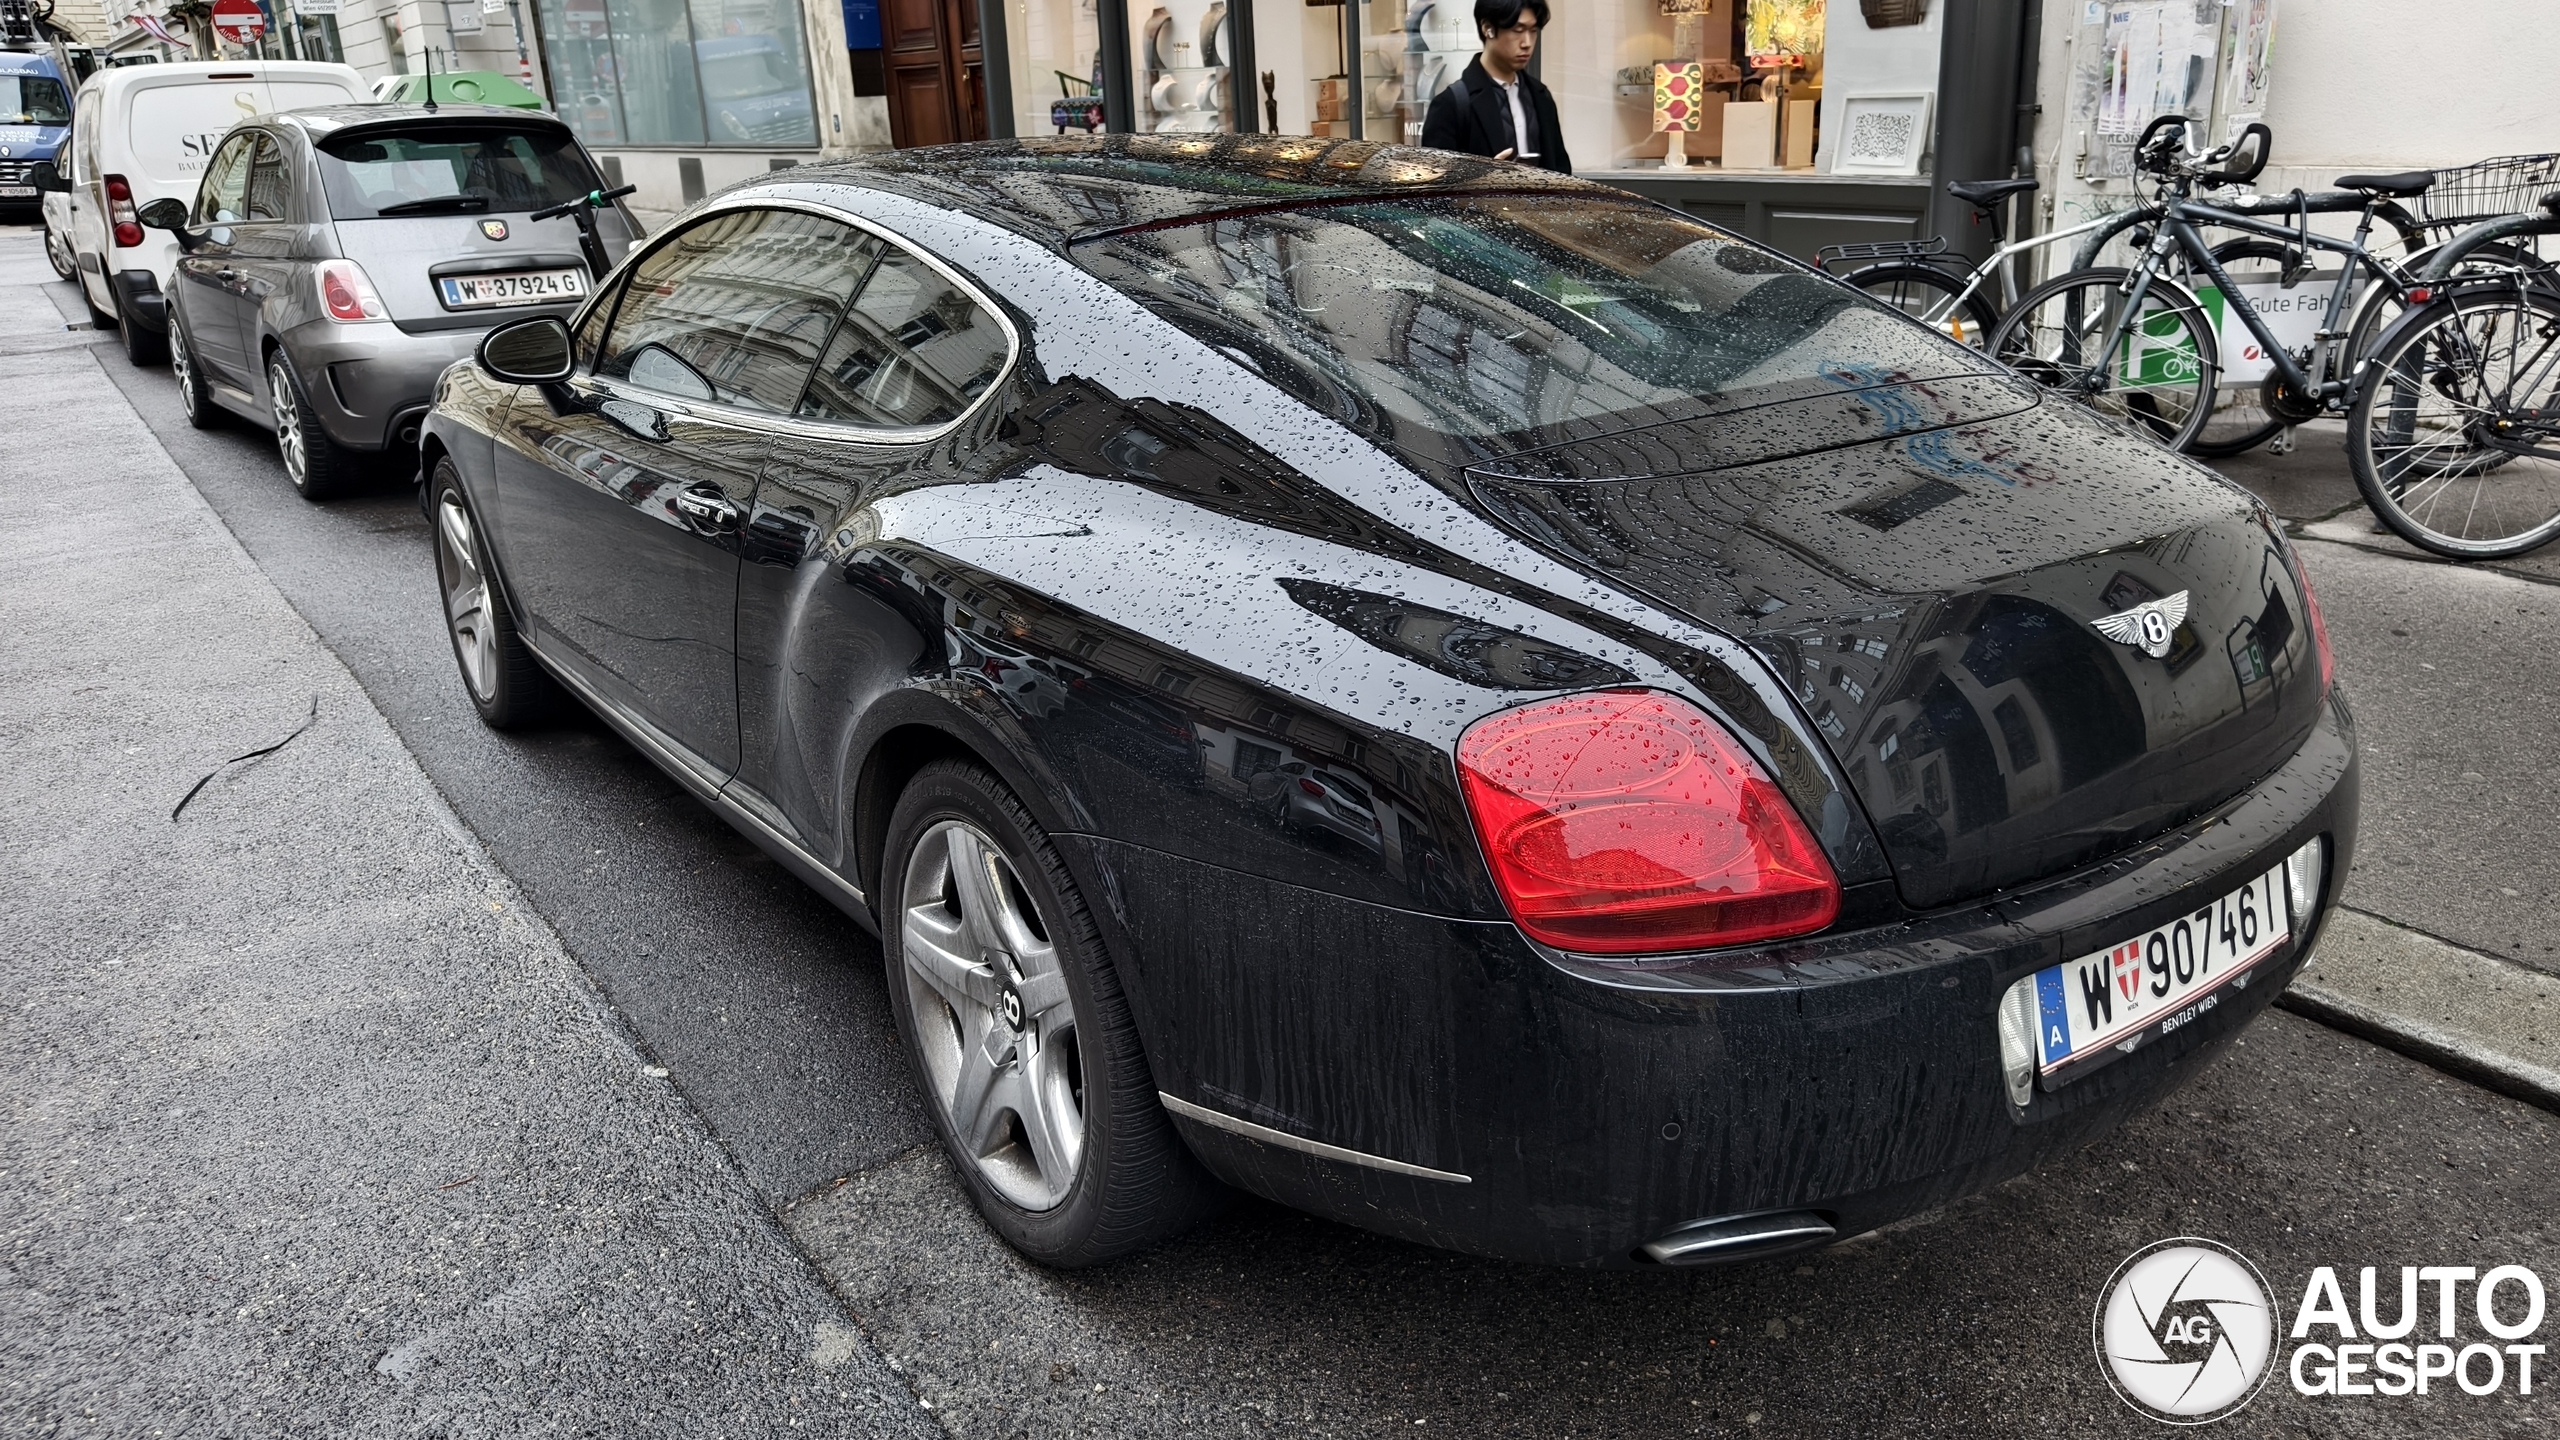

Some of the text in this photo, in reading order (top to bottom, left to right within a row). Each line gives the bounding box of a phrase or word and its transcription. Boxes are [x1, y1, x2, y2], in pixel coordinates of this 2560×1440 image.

[0, 66, 39, 75] LASBAU
[460, 281, 478, 300] W
[562, 274, 576, 292] G
[2249, 296, 2291, 313] Gute
[2079, 955, 2112, 1031] W
[2145, 884, 2258, 998] 90746
[2127, 1002, 2139, 1011] WIEN
[2162, 993, 2218, 1034] BENTLEY WIEN
[2050, 1025, 2064, 1048] A
